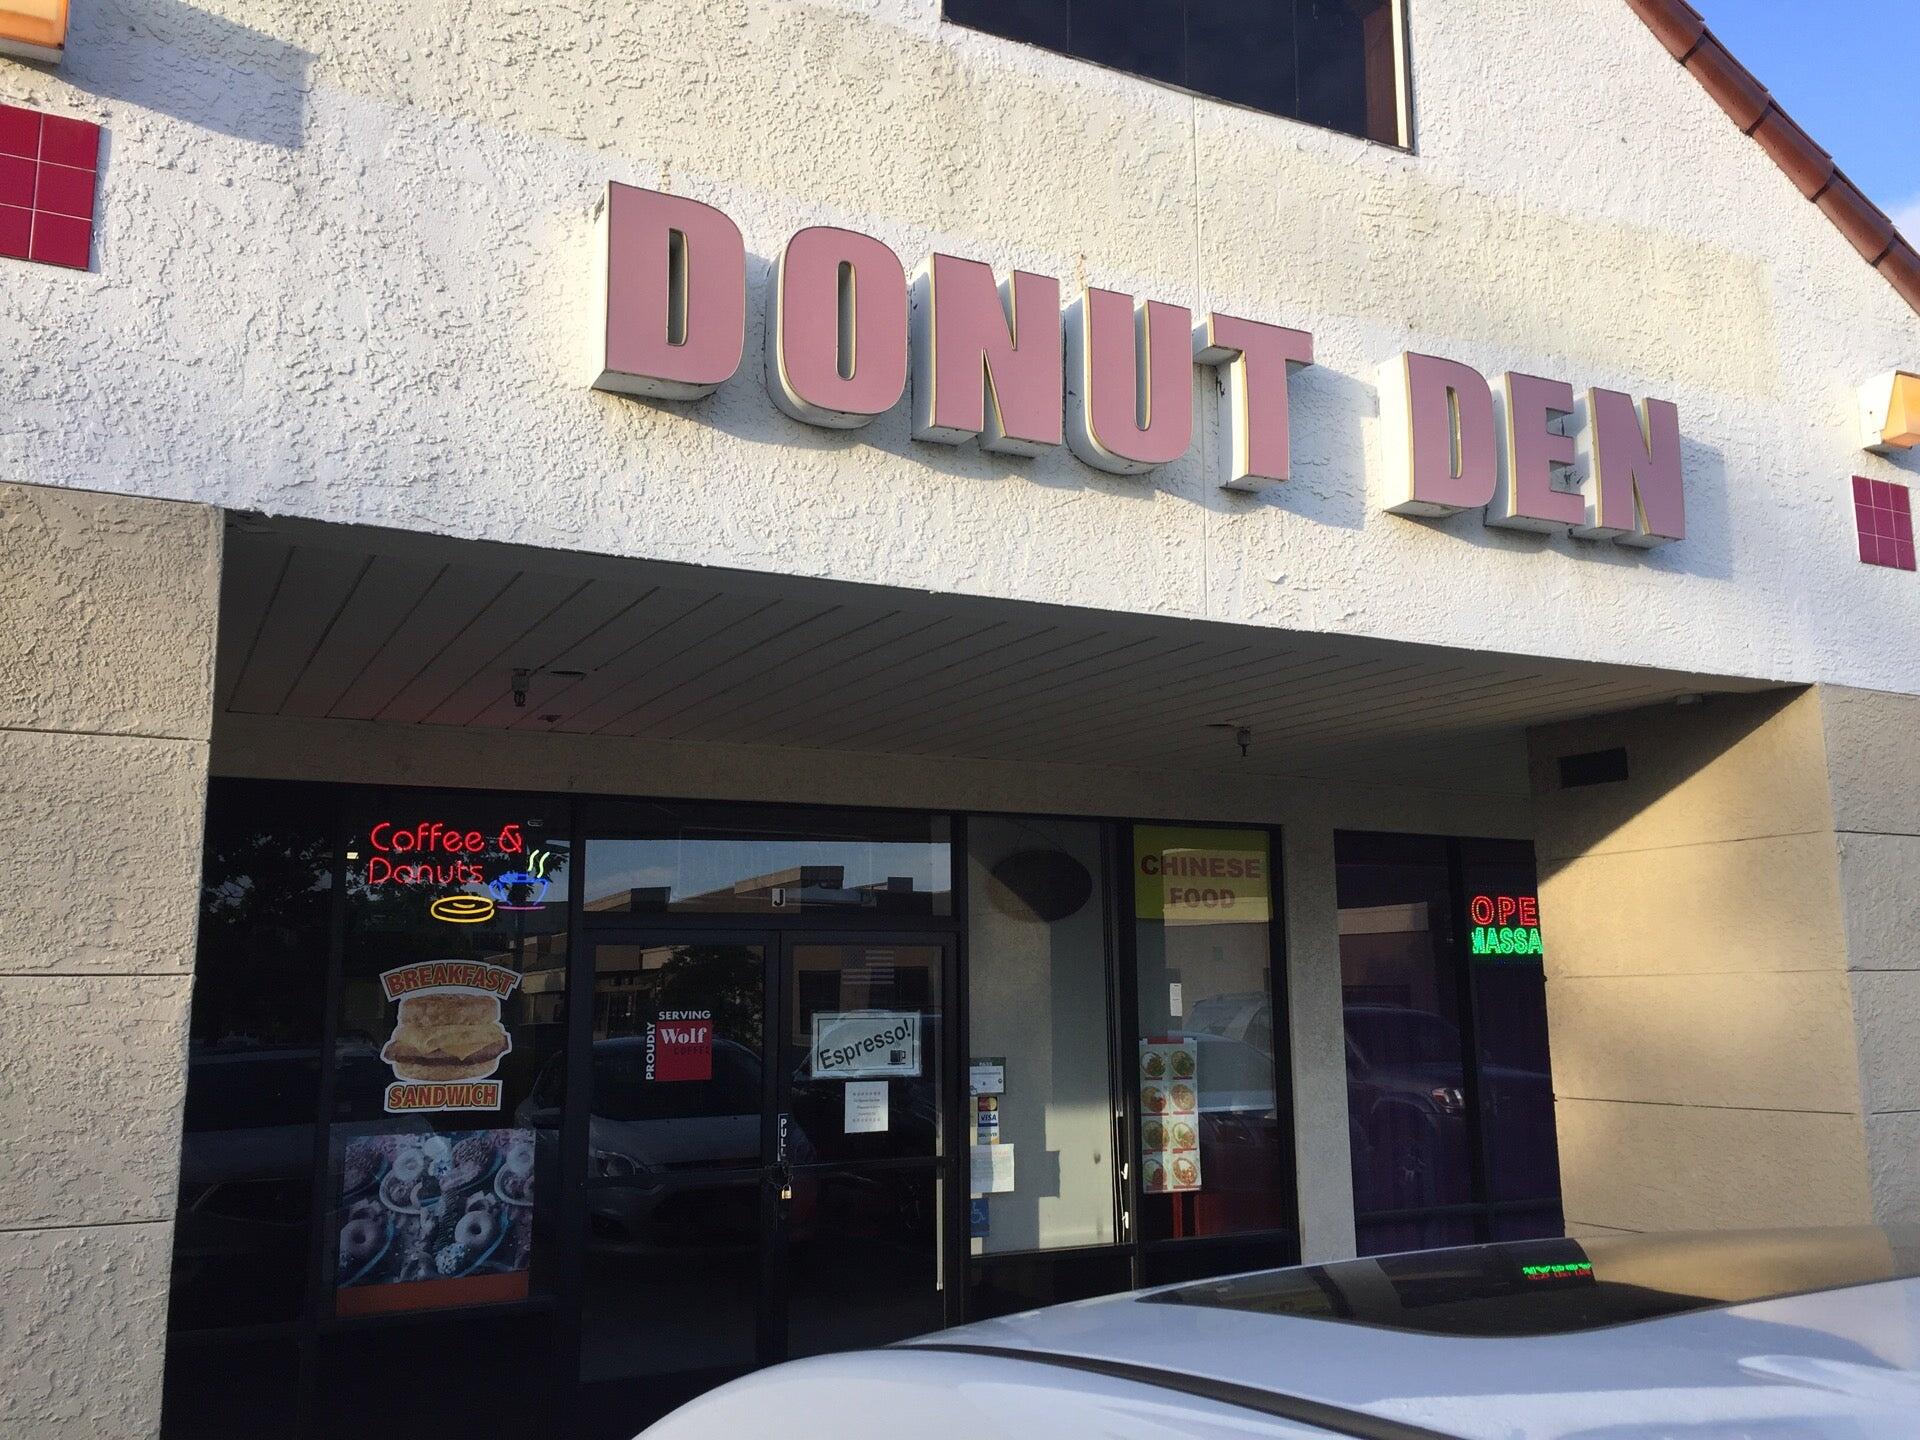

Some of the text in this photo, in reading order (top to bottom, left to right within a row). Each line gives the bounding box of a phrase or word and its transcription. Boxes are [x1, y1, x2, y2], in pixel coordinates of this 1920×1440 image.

[592, 181, 1686, 548] DONUT DEN
[370, 823, 523, 853] Coffee &
[368, 857, 484, 885] Donuts
[1141, 855, 1261, 878] CHINESE
[773, 889, 784, 906] J
[1170, 888, 1236, 909] FOOD
[386, 963, 516, 996] BREAKFAST
[658, 1010, 712, 1021] SERVING
[660, 1027, 708, 1045] Wolf
[819, 1018, 912, 1070] Espresso!
[645, 1022, 656, 1081] PROUDLY
[387, 1084, 498, 1109] SANDWICH
[980, 1112, 998, 1122] VISA
[780, 1118, 788, 1157] PULL
